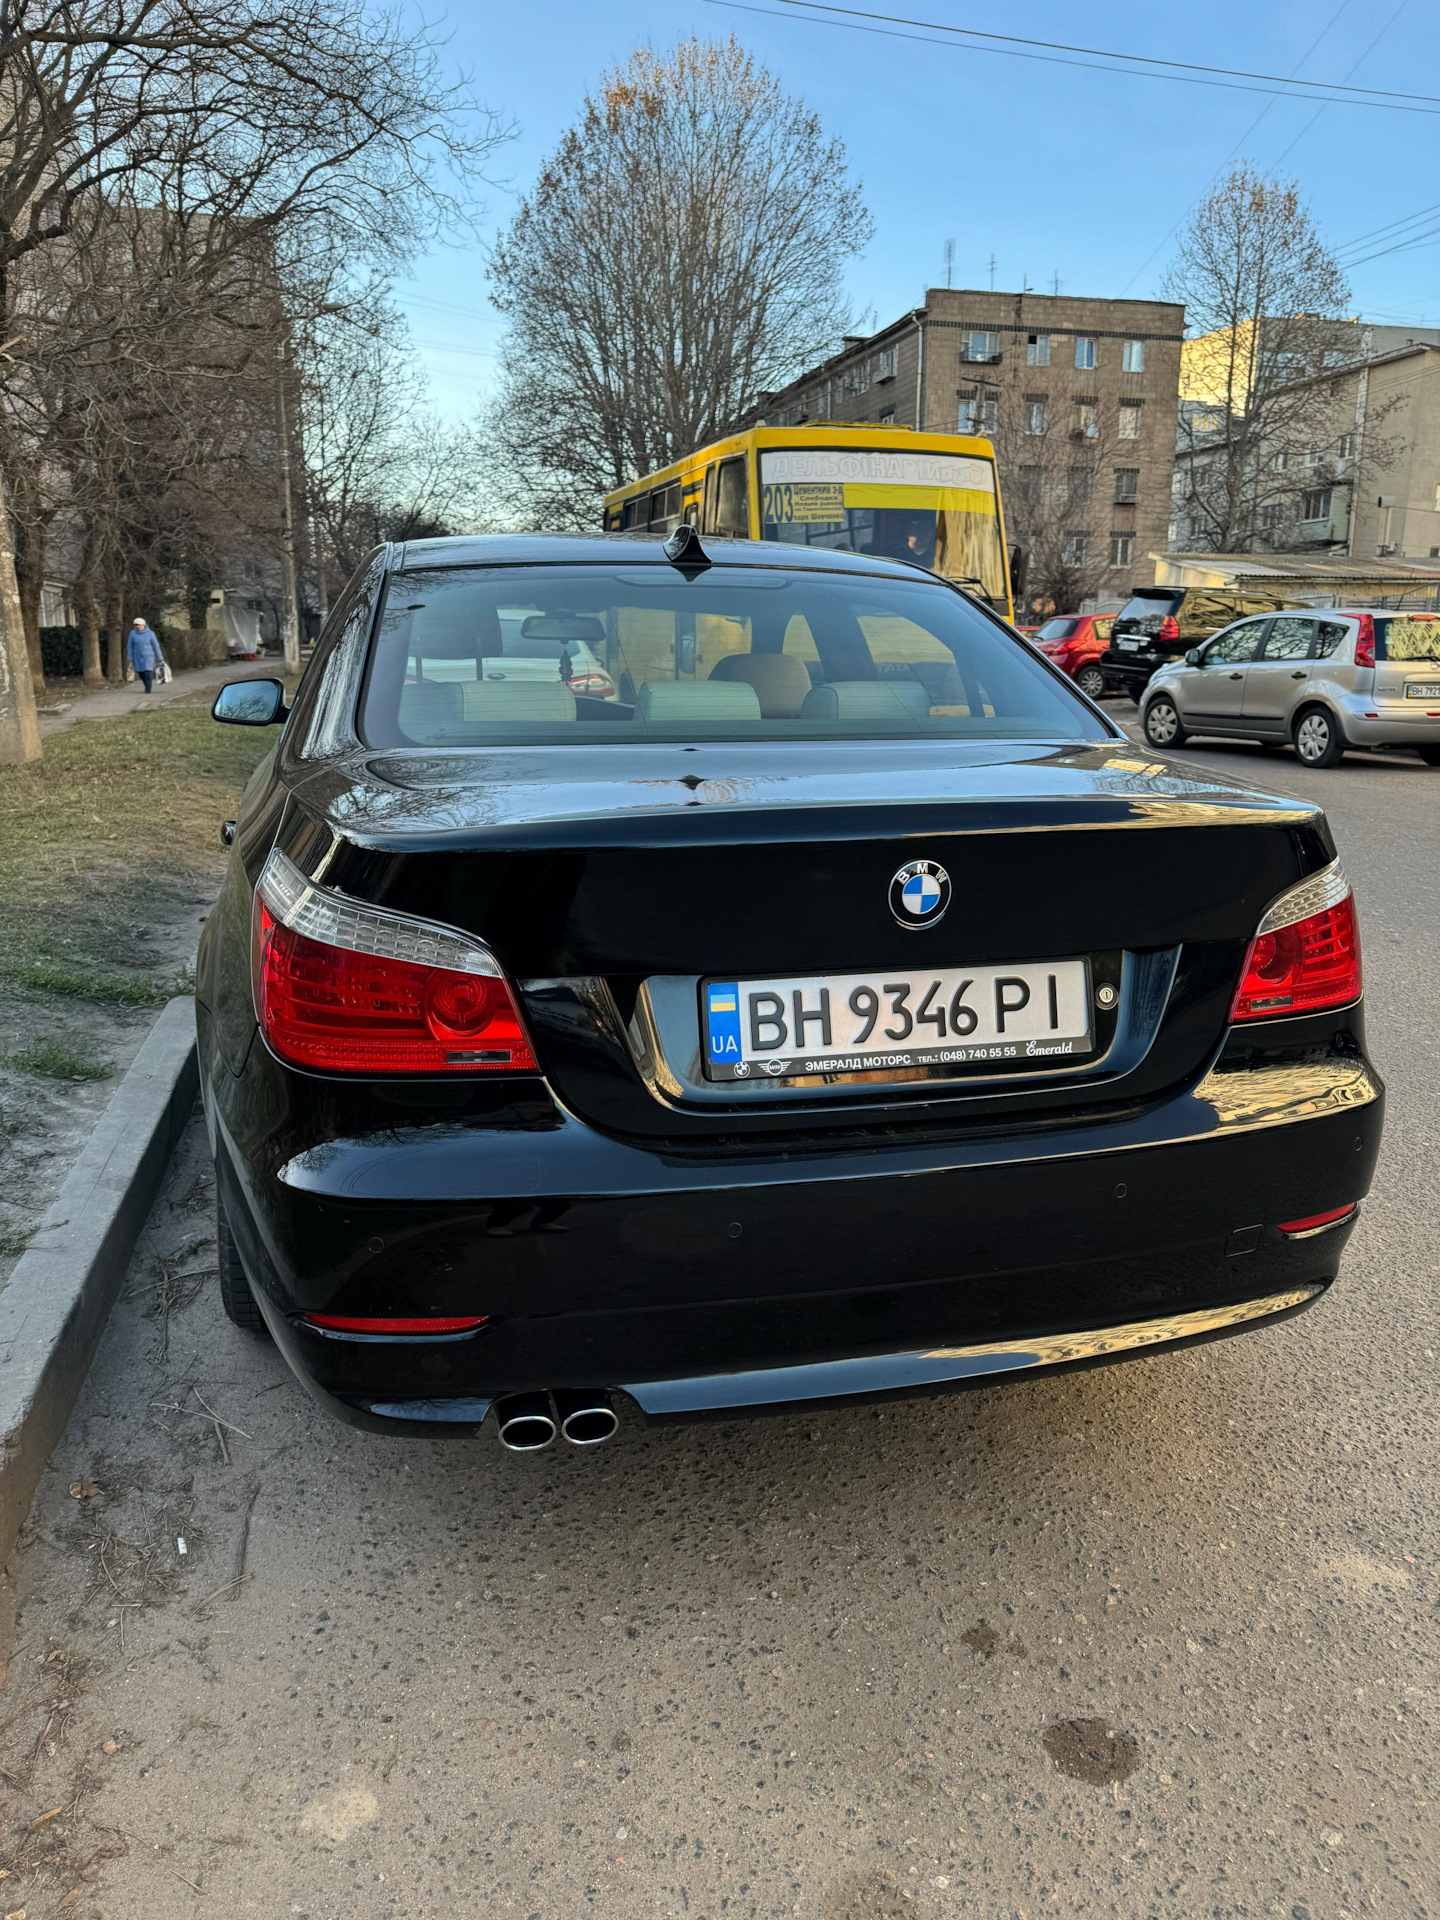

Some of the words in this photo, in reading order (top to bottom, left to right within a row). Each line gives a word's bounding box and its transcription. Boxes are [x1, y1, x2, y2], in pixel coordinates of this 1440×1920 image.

[764, 485, 793, 523] 203
[896, 862, 948, 885] BMW
[749, 987, 832, 1051] BH
[849, 979, 978, 1043] 9346
[995, 973, 1058, 1033] PI
[712, 1035, 738, 1053] UA
[1026, 1040, 1072, 1056] Emerald
[805, 1058, 861, 1071] ЭМЕРАЛД
[863, 1054, 911, 1068] МОТОРС
[940, 1049, 967, 1063] (048)
[968, 1049, 987, 1060] 740
[989, 1047, 1002, 1058] 55
[1003, 1046, 1017, 1057] 55
